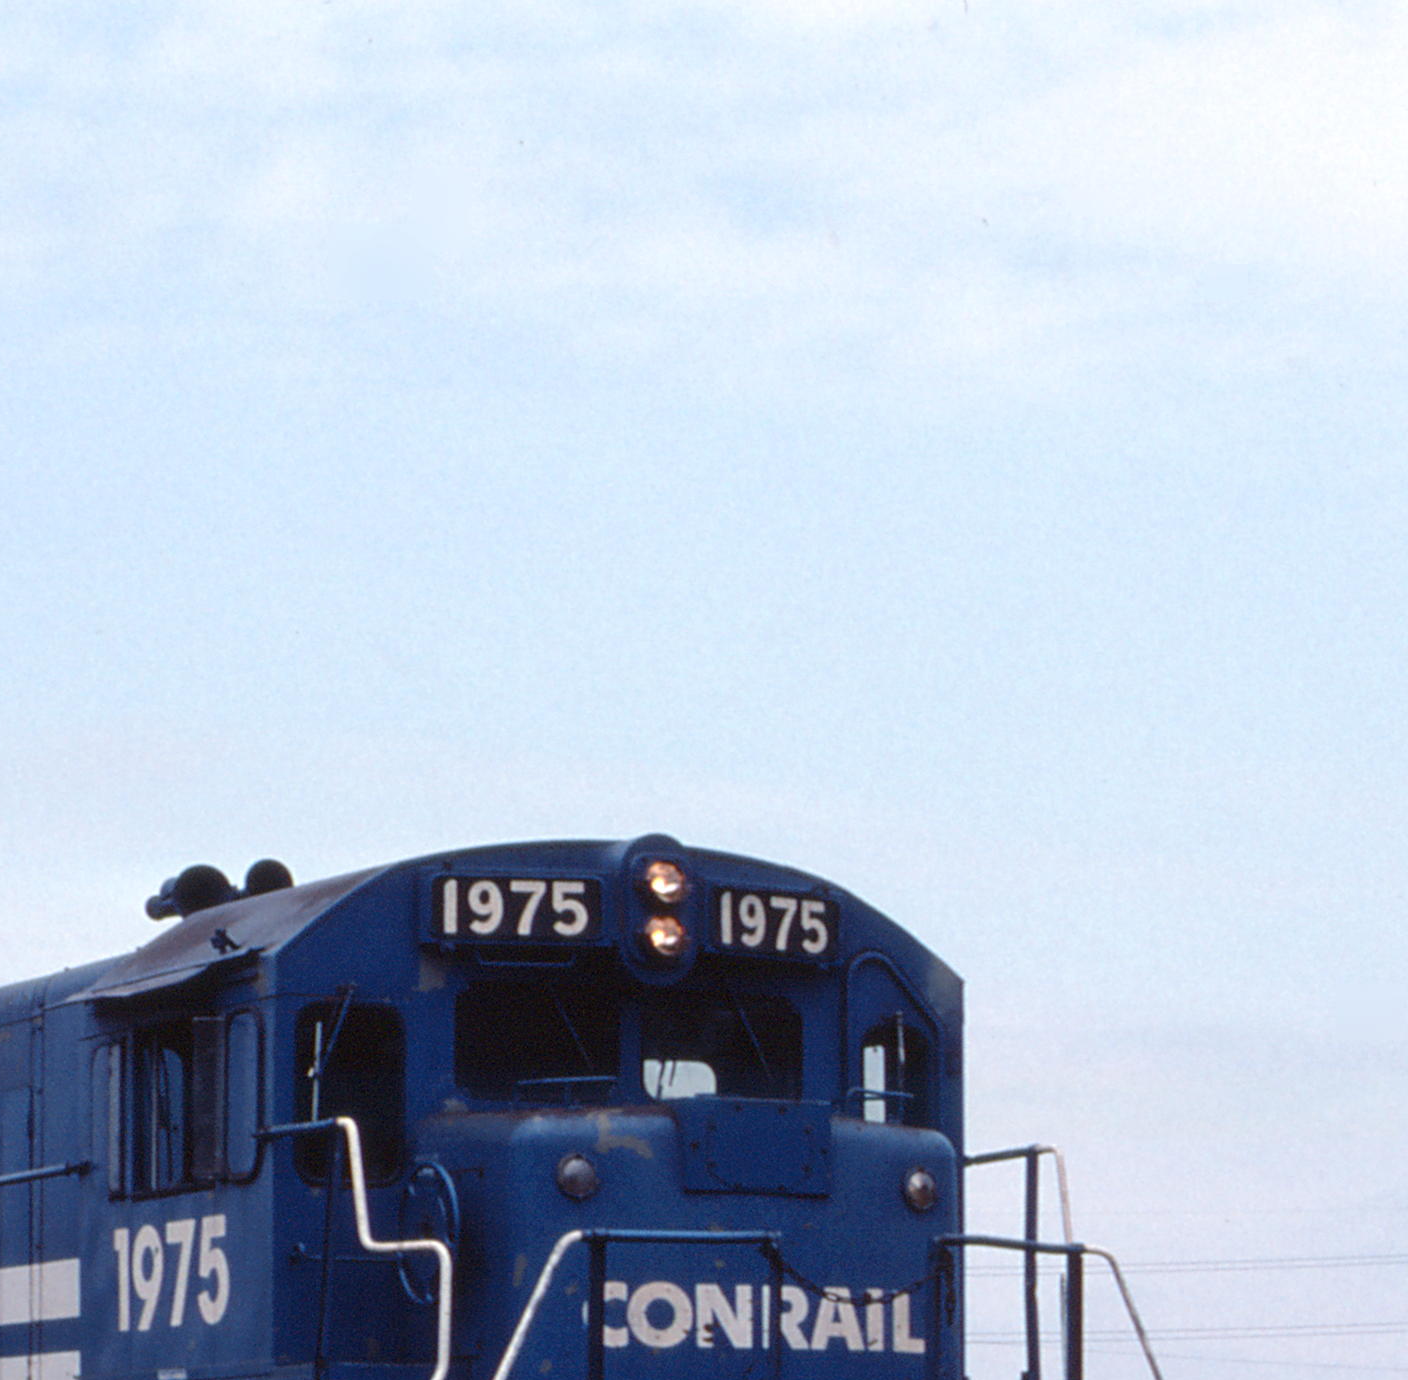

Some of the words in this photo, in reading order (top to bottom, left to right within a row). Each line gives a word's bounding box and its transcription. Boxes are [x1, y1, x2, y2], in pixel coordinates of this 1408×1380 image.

[442, 878, 590, 937] 1975
[720, 890, 829, 955] 1975
[113, 1213, 231, 1333] 1975
[581, 1280, 927, 1355] CONRAIL
